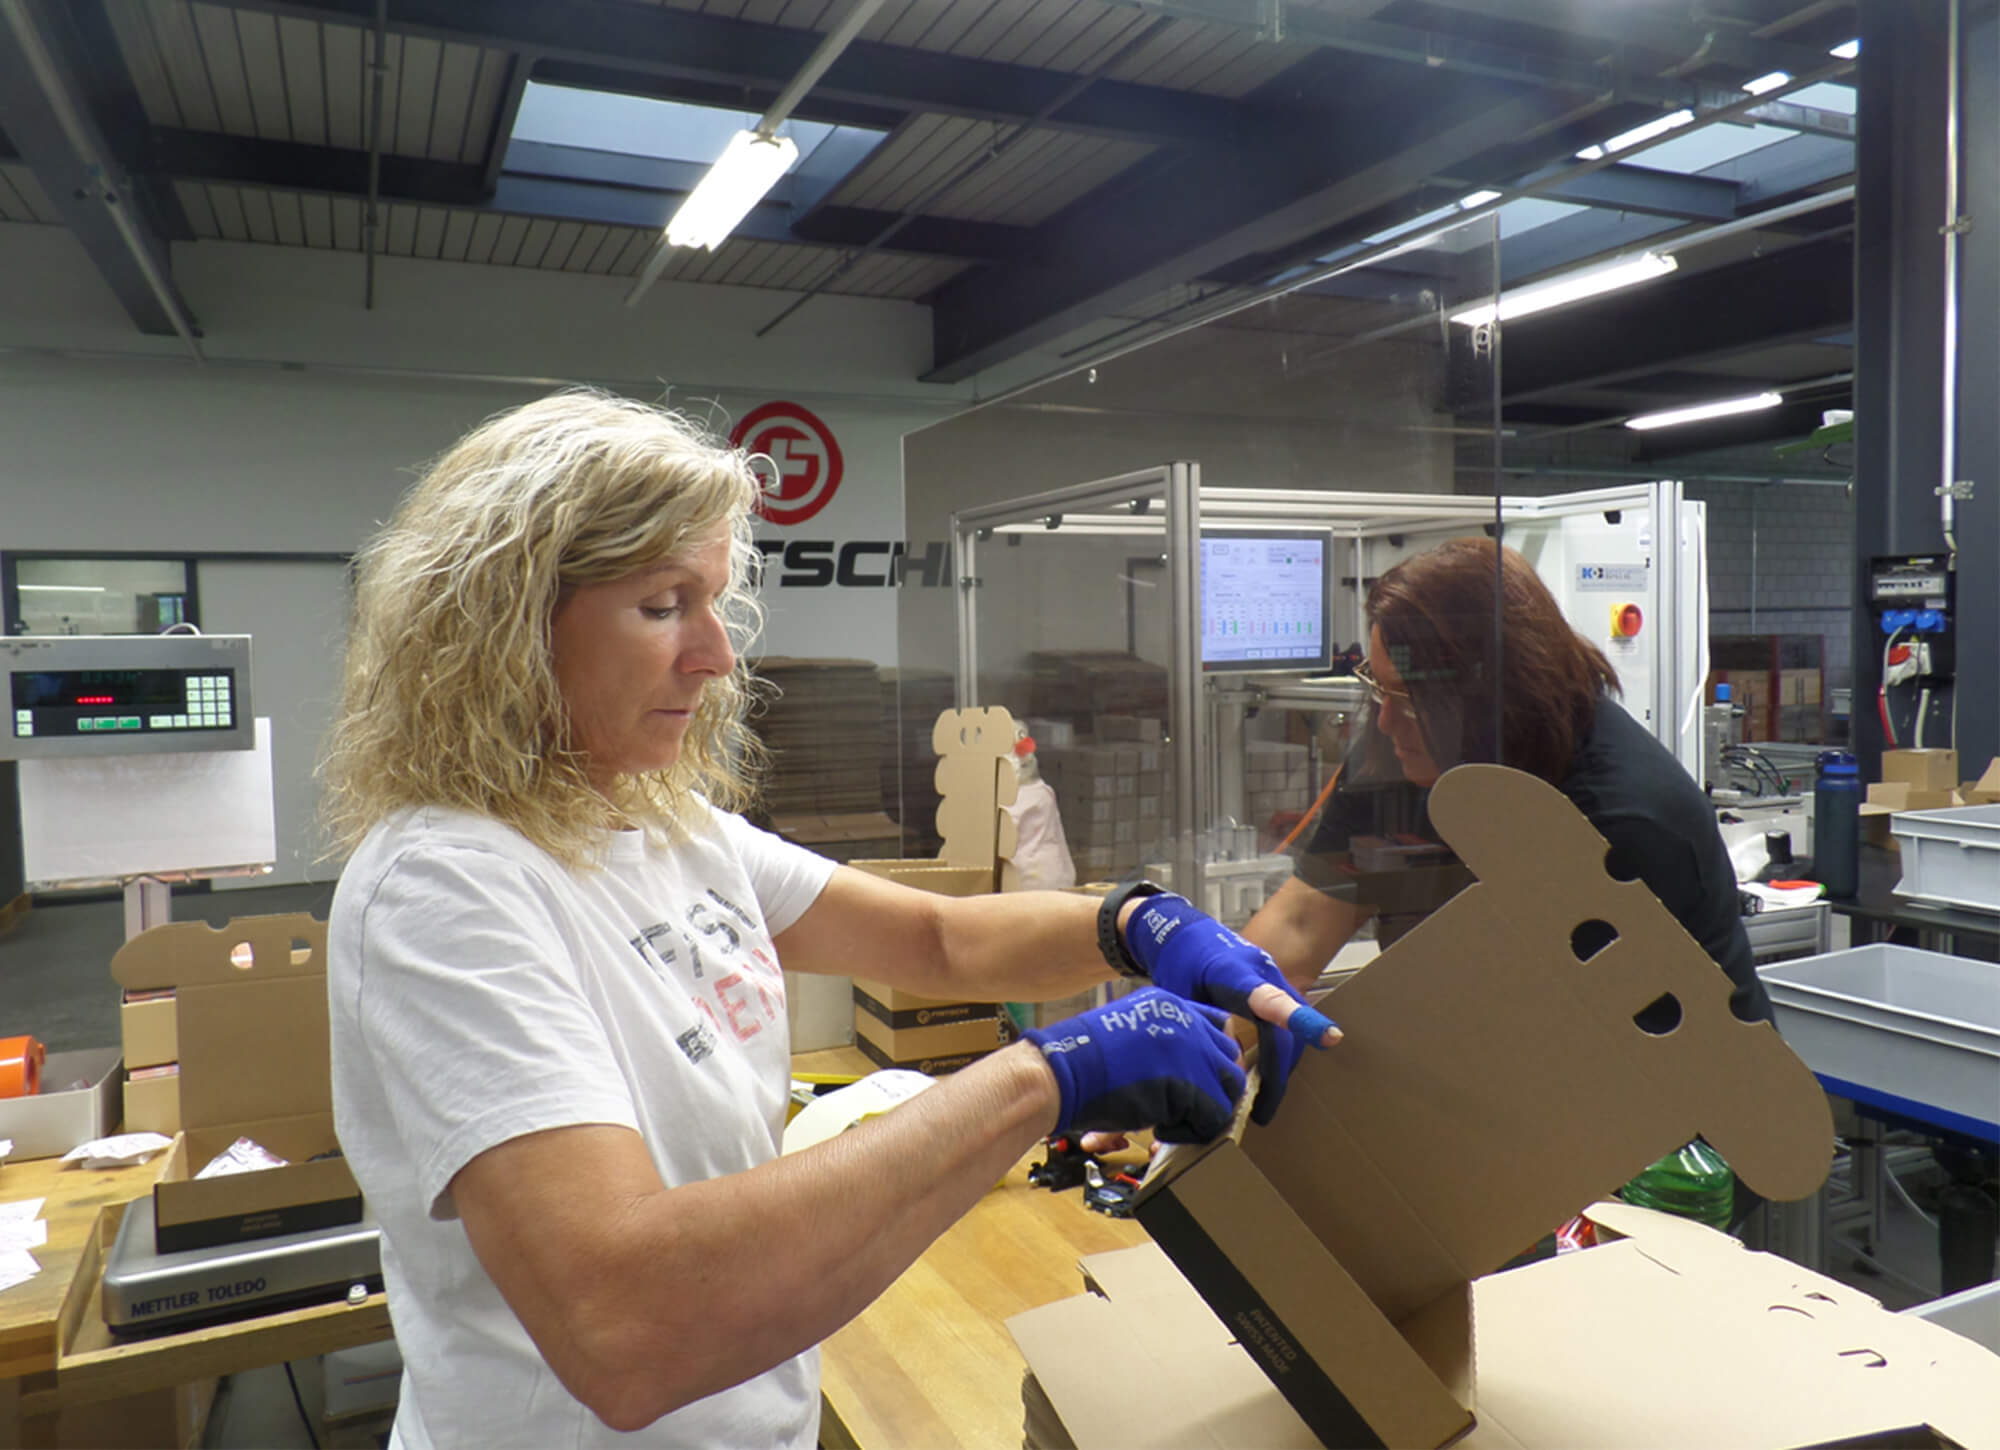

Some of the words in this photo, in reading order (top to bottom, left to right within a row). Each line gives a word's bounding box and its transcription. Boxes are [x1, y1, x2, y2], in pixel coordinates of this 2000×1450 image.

[1099, 999, 1189, 1033] HyFlex
[130, 1289, 199, 1318] METTLER
[207, 1277, 267, 1303] TOLEDO
